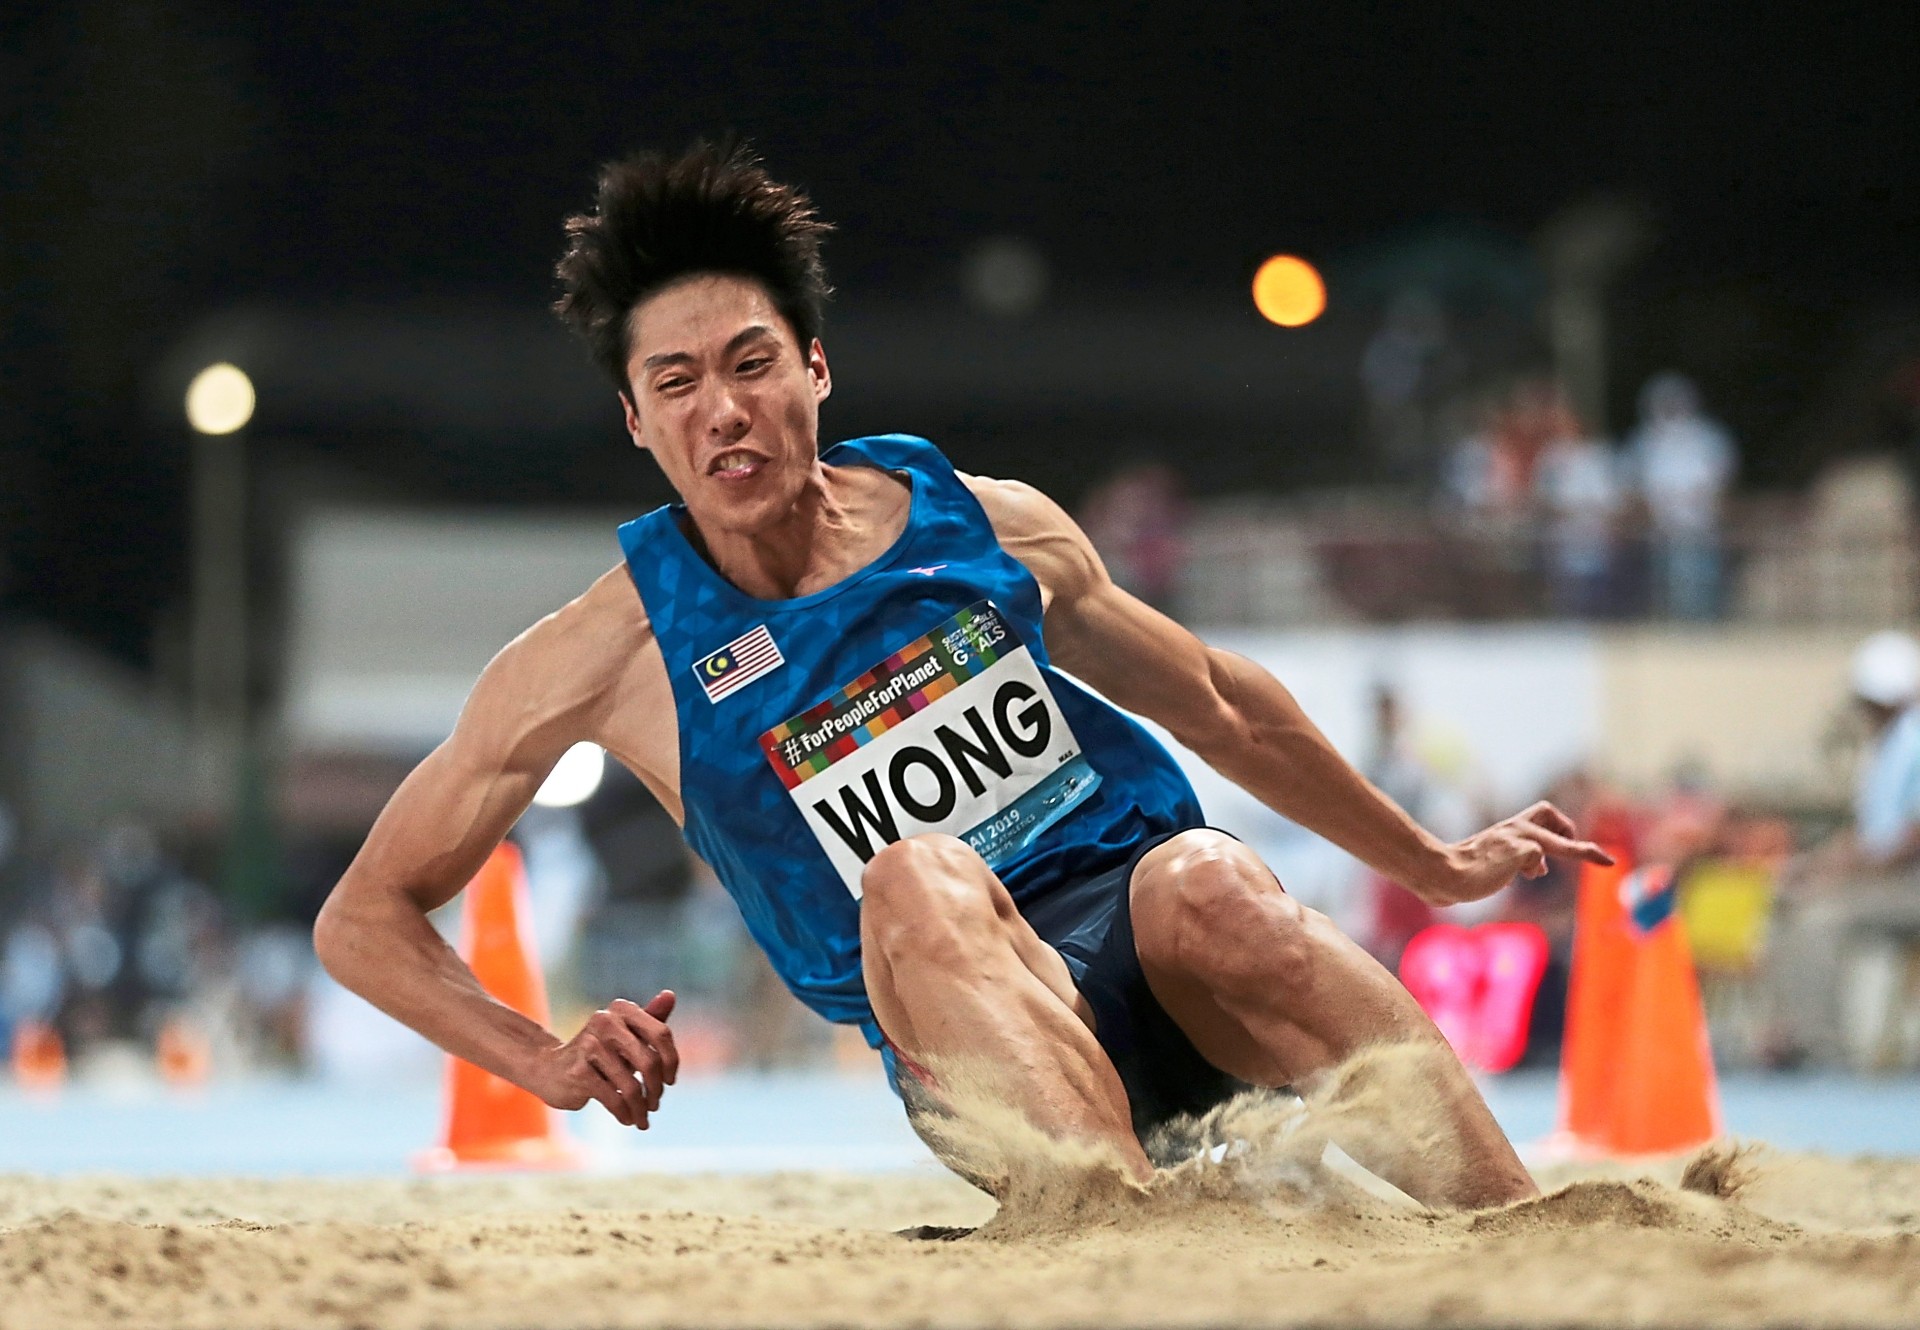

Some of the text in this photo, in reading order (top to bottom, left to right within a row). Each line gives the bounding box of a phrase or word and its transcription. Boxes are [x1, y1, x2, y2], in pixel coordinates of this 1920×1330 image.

[945, 618, 999, 655] DEVELOPMENT
[812, 680, 1052, 865] WONG
[969, 809, 1020, 849] AI 2019
[978, 813, 1036, 856] ARA ATHLETICS
[985, 840, 1013, 861] NSHIPS
